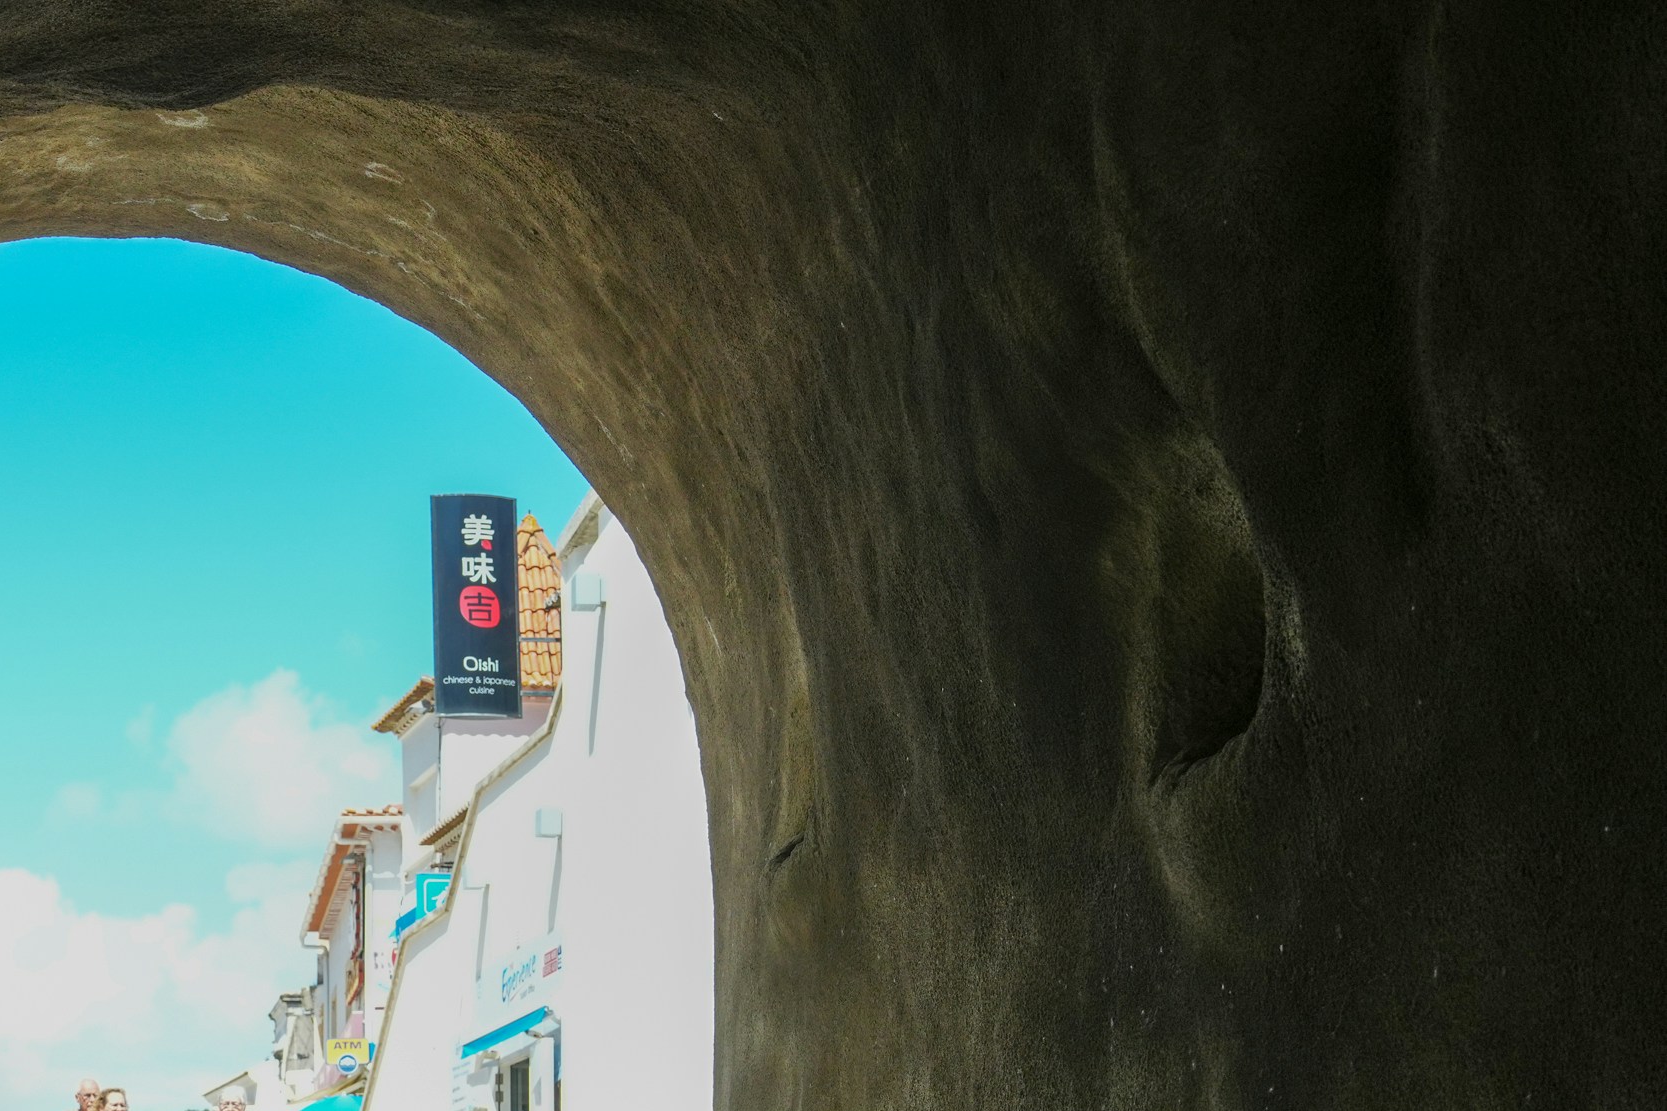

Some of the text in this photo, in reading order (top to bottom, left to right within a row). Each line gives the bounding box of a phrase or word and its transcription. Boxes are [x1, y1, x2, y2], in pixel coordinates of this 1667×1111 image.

[461, 513, 497, 623] 美味吉
[462, 656, 499, 673] Oishi
[442, 675, 516, 687] chinese & japanese
[468, 686, 495, 695] cuisine
[333, 1041, 362, 1050] ATM
